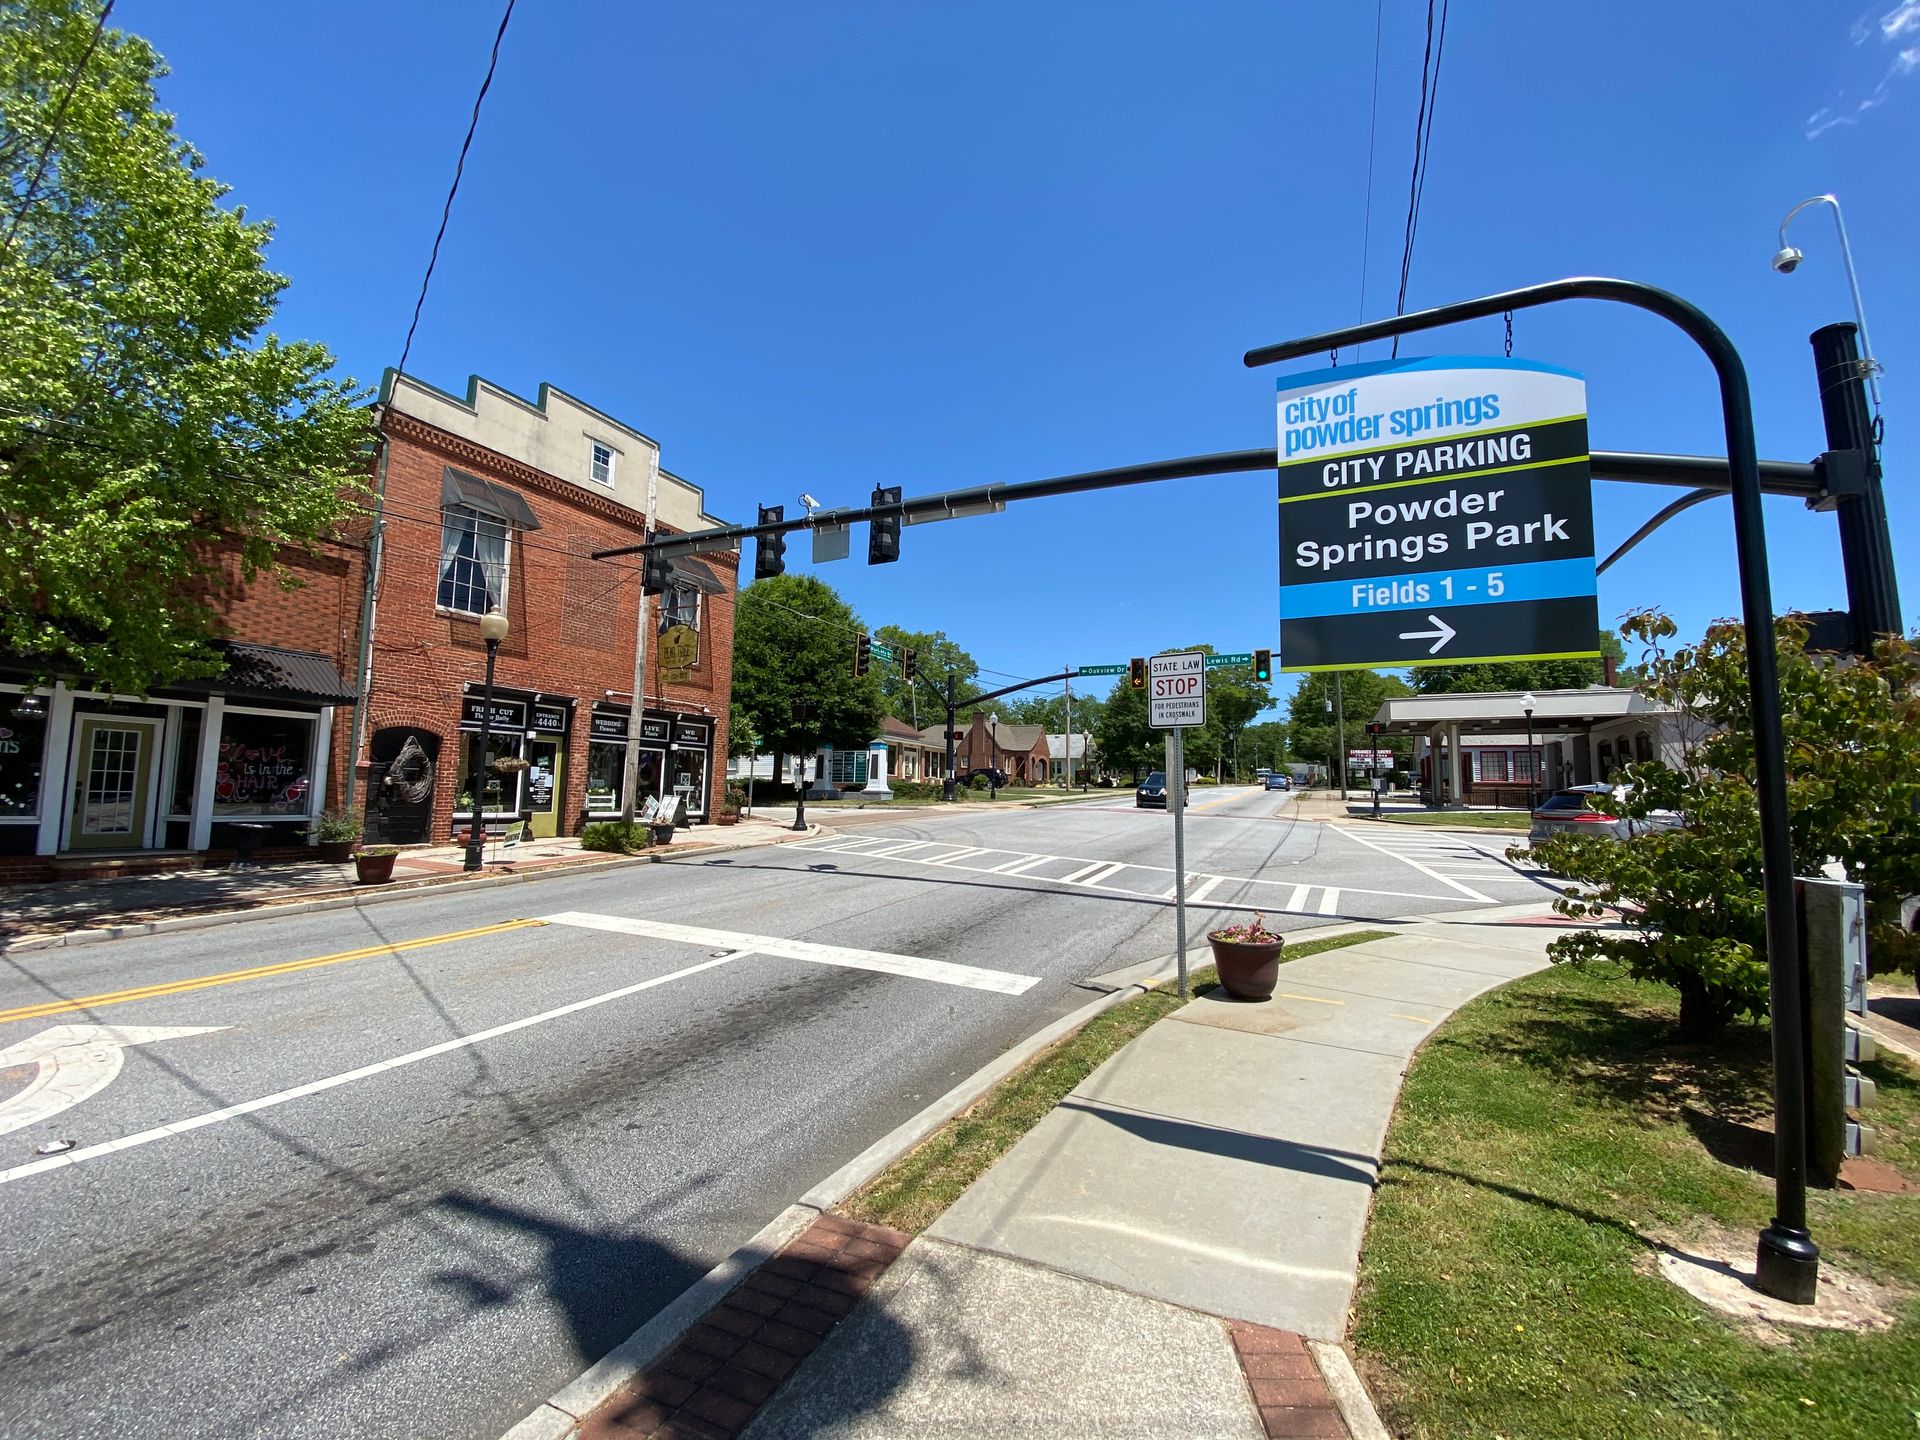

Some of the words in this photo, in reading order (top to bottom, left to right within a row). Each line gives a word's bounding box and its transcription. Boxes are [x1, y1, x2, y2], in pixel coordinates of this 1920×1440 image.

[1285, 395, 1331, 425] city
[1333, 388, 1358, 416] of
[1285, 412, 1385, 456] powder
[1390, 393, 1500, 437] springs
[1323, 455, 1386, 488] CITY
[1396, 433, 1532, 477] PARKING
[1348, 489, 1505, 529] Powder
[1295, 531, 1449, 571] Springs
[1466, 513, 1571, 550] Park
[1351, 580, 1430, 608] Fields
[1440, 576, 1453, 600] 1
[1487, 572, 1505, 597] 5
[1153, 662, 1178, 672] STATE
[1182, 660, 1200, 670] LAW
[1206, 657, 1228, 665] Lewis
[1156, 677, 1198, 696] STOP
[499, 708, 514, 716] CUT
[1154, 702, 1165, 710] FOR
[1165, 701, 1200, 709] PEDESTRIANS
[595, 719, 622, 727] WEDDING
[599, 725, 616, 733] Flowers
[259, 763, 271, 775] in
[274, 763, 294, 775] the
